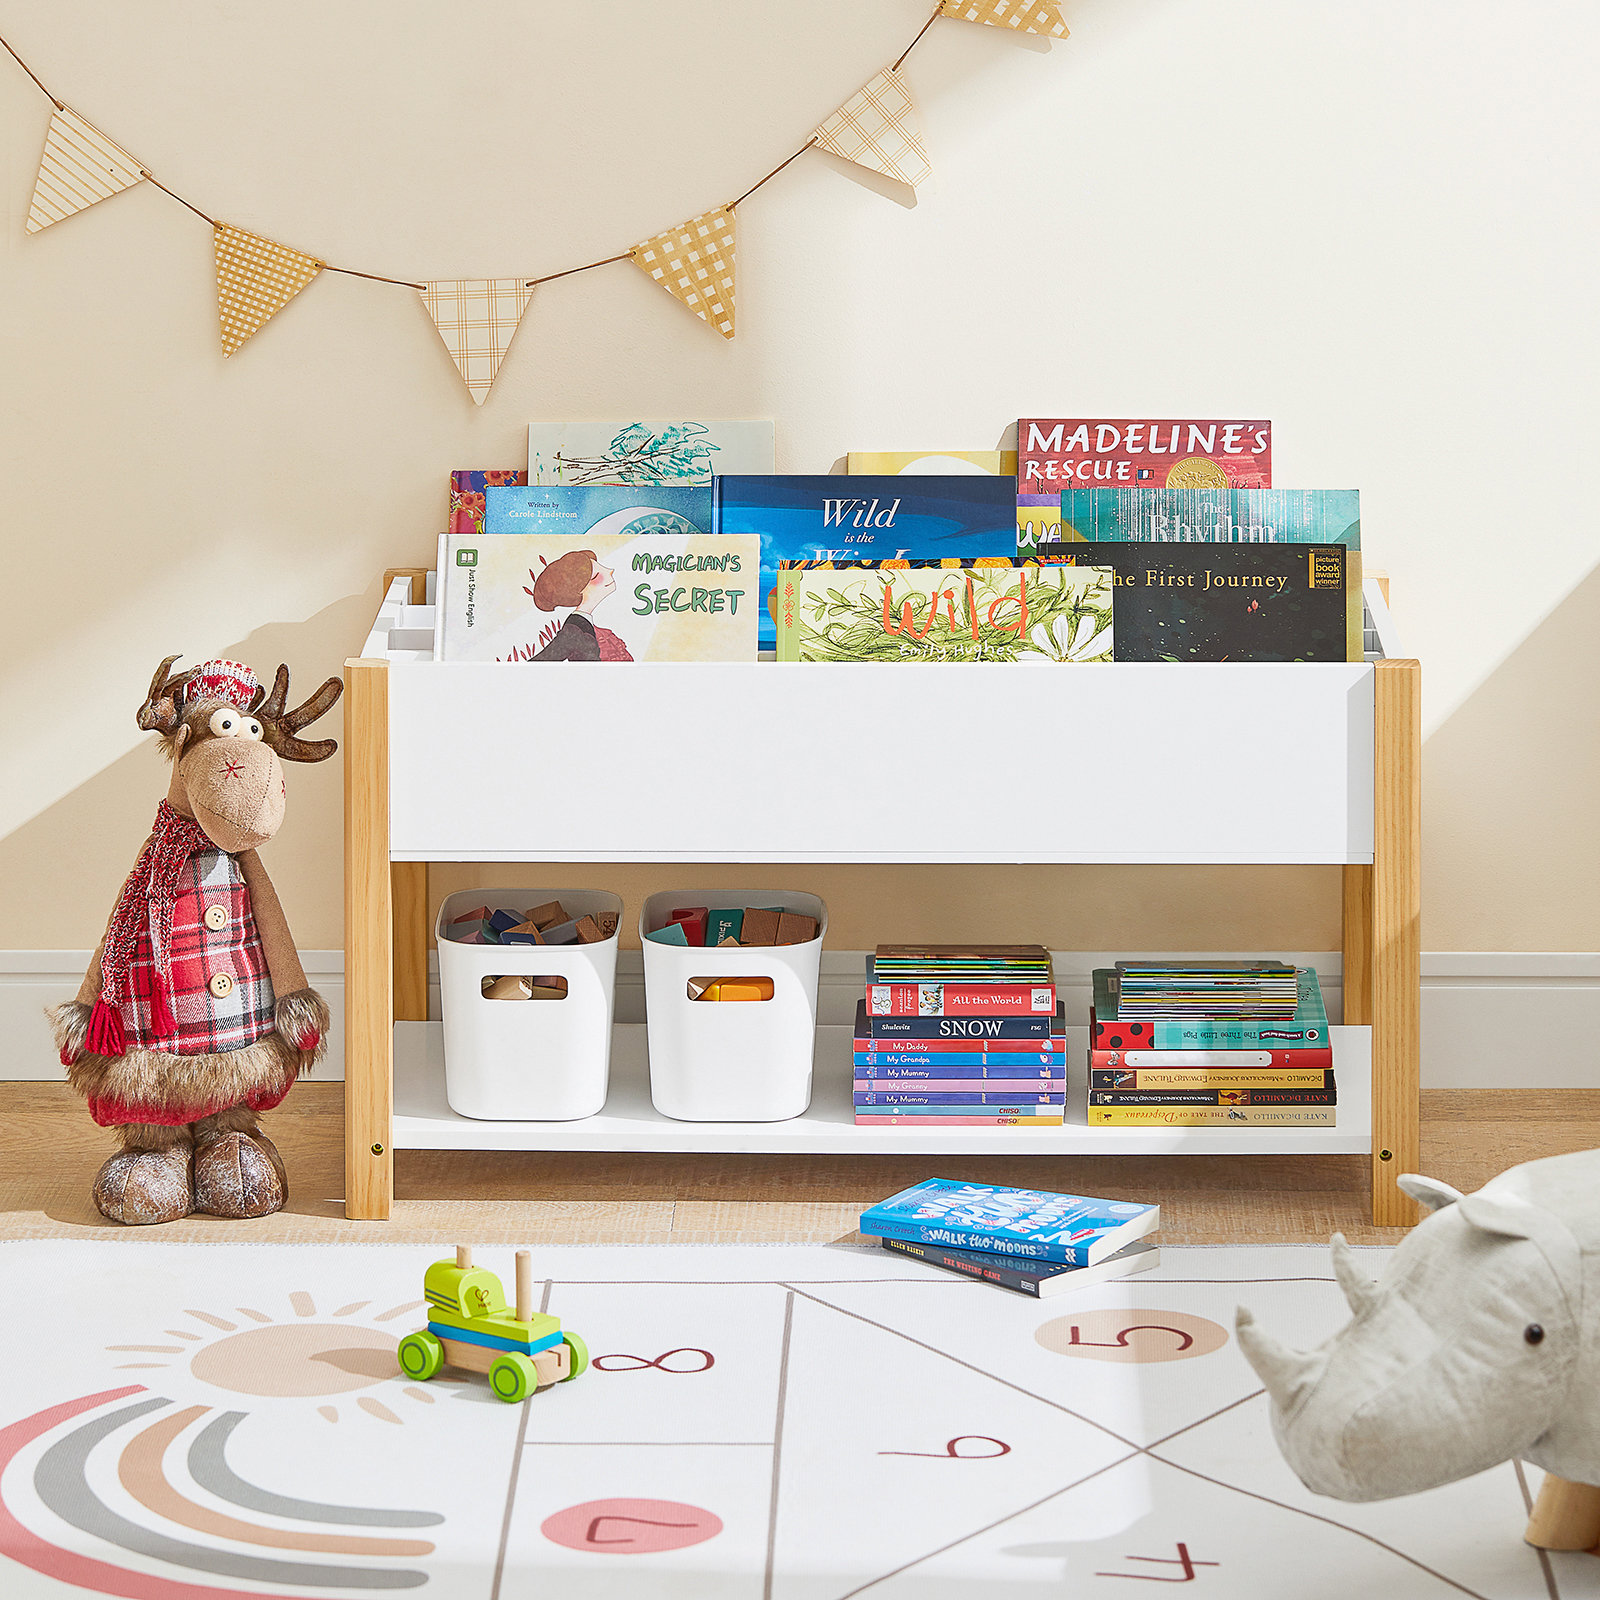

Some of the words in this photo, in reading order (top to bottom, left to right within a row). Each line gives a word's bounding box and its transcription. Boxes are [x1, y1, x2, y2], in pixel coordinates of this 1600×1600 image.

[1026, 422, 1270, 454] MADELINE's
[1025, 459, 1132, 481] RESCUE
[508, 510, 534, 518] Carole
[537, 510, 578, 518] Lindstrom
[822, 498, 901, 528] Wild
[844, 532, 855, 543] is
[856, 532, 875, 543] the
[632, 552, 741, 573] MAGICIAN'S
[1316, 564, 1339, 572] book
[468, 568, 476, 582] Just
[1113, 570, 1135, 588] he
[1146, 570, 1194, 588] First
[1203, 570, 1288, 593] Journey
[632, 583, 745, 616] SECRET
[466, 604, 475, 628] English
[900, 643, 946, 660] Emily
[955, 640, 1014, 660] Hughes
[952, 996, 970, 1005] All
[972, 996, 989, 1005] the
[990, 996, 1022, 1005] World
[939, 1020, 1004, 1036] SNOW
[1183, 1030, 1198, 1039] Pigs
[1200, 1031, 1218, 1039] Little
[1220, 1031, 1240, 1039] Three
[1244, 1031, 1257, 1039] The
[893, 1042, 904, 1051] My
[906, 1042, 928, 1052] Daddy
[887, 1056, 898, 1064] My
[900, 1055, 930, 1064] Grandpa
[888, 1069, 899, 1078] My
[901, 1069, 930, 1078] Mummy
[888, 1082, 900, 1090] My
[902, 1082, 928, 1090] Granny
[886, 1096, 898, 1104] My
[900, 1096, 928, 1104] Mummy
[1303, 1094, 1328, 1102] KATE
[1124, 1110, 1178, 1122] Despereaux
[870, 1222, 893, 1232] Sharon
[894, 1225, 915, 1235] Creech
[929, 1228, 966, 1246] WALK
[890, 1240, 906, 1252] ELLEN
[906, 1244, 924, 1256] RASKIN
[944, 1256, 956, 1266] THE
[956, 1260, 982, 1276] WESTING
[984, 1268, 1001, 1281] GAME
[1070, 1325, 1194, 1353] 5
[592, 1348, 715, 1374] 8
[586, 1515, 699, 1545] 7
[1095, 1542, 1220, 1582] 4
